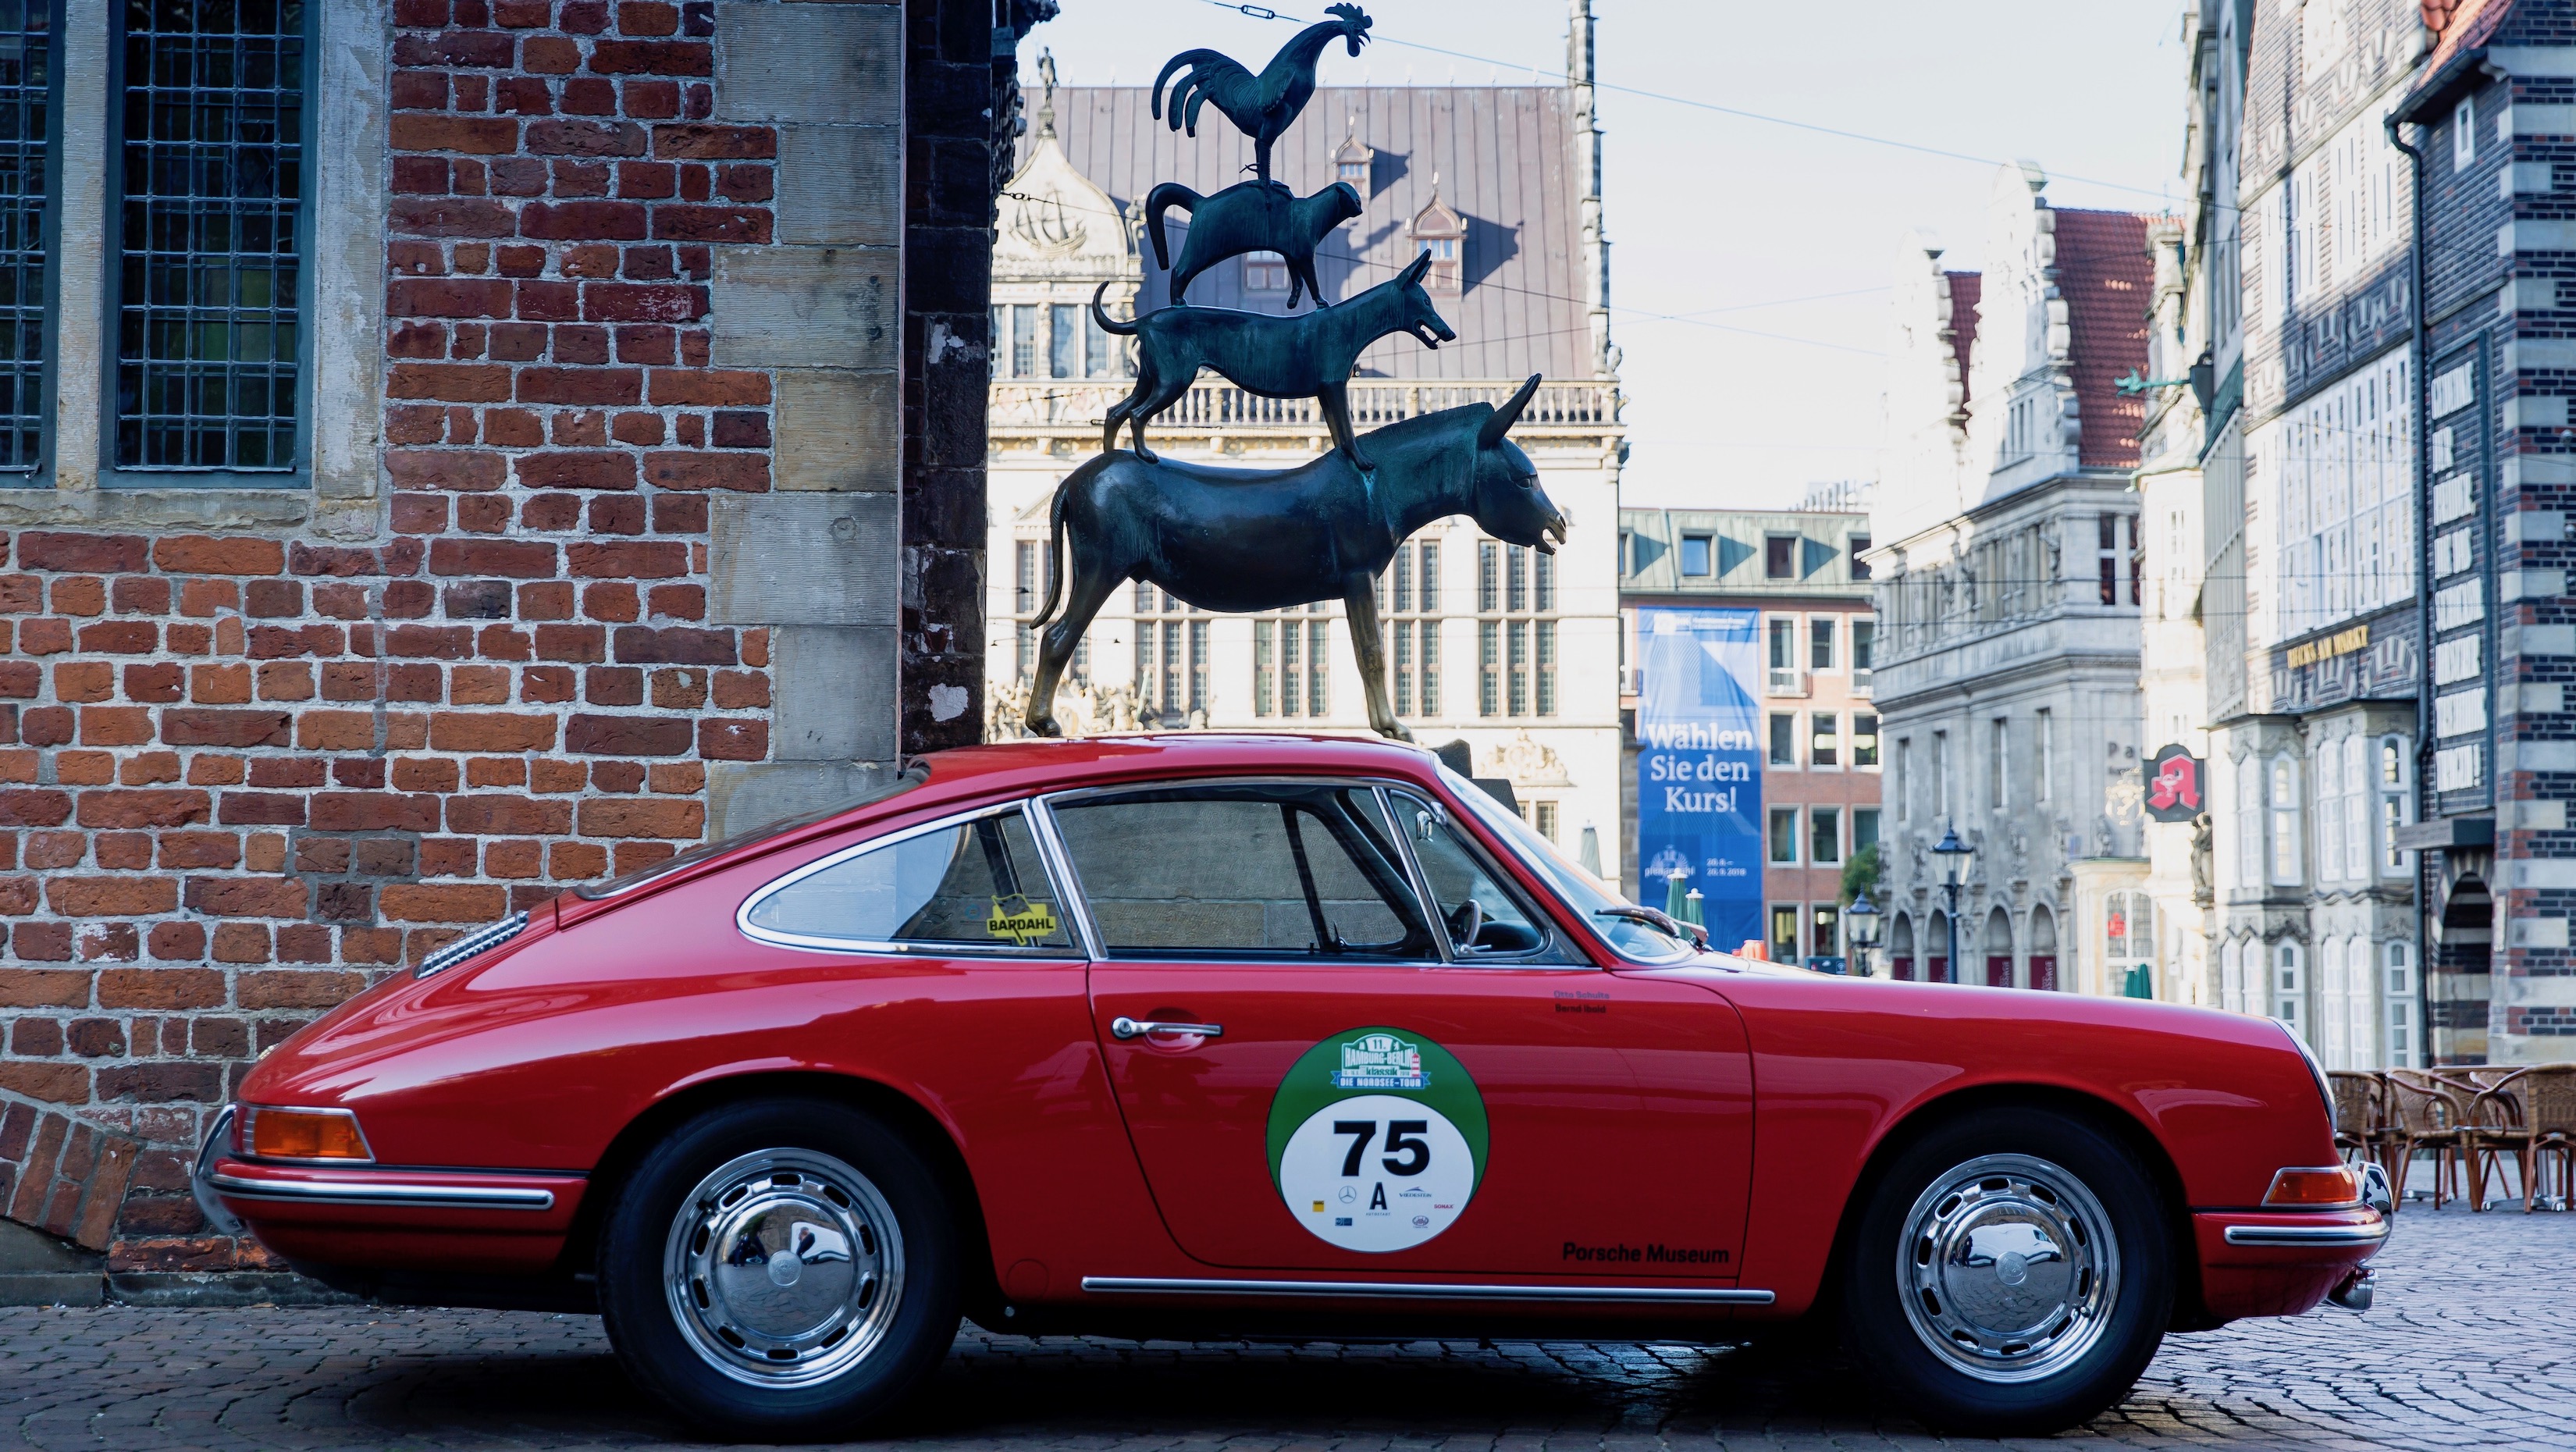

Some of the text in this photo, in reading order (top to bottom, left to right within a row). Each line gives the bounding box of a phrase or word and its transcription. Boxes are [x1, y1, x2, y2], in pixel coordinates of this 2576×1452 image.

[1646, 721, 1753, 750] Wählen
[1650, 753, 1751, 781] Sie den
[1664, 785, 1737, 813] Kurs!
[989, 918, 1054, 931] BARDAHL
[1553, 990, 1574, 998] Otto
[1555, 1004, 1582, 1012] Bernd
[1373, 1039, 1386, 1050] 11.
[1345, 1047, 1414, 1068] HAMBURG-BERLIN
[1366, 1066, 1398, 1076] klassik
[1340, 1078, 1421, 1087] DIE NORDSEE-TOUR
[1332, 1119, 1430, 1177] 75
[1369, 1182, 1388, 1210] A
[1562, 1242, 1730, 1264] Porsche Museum
